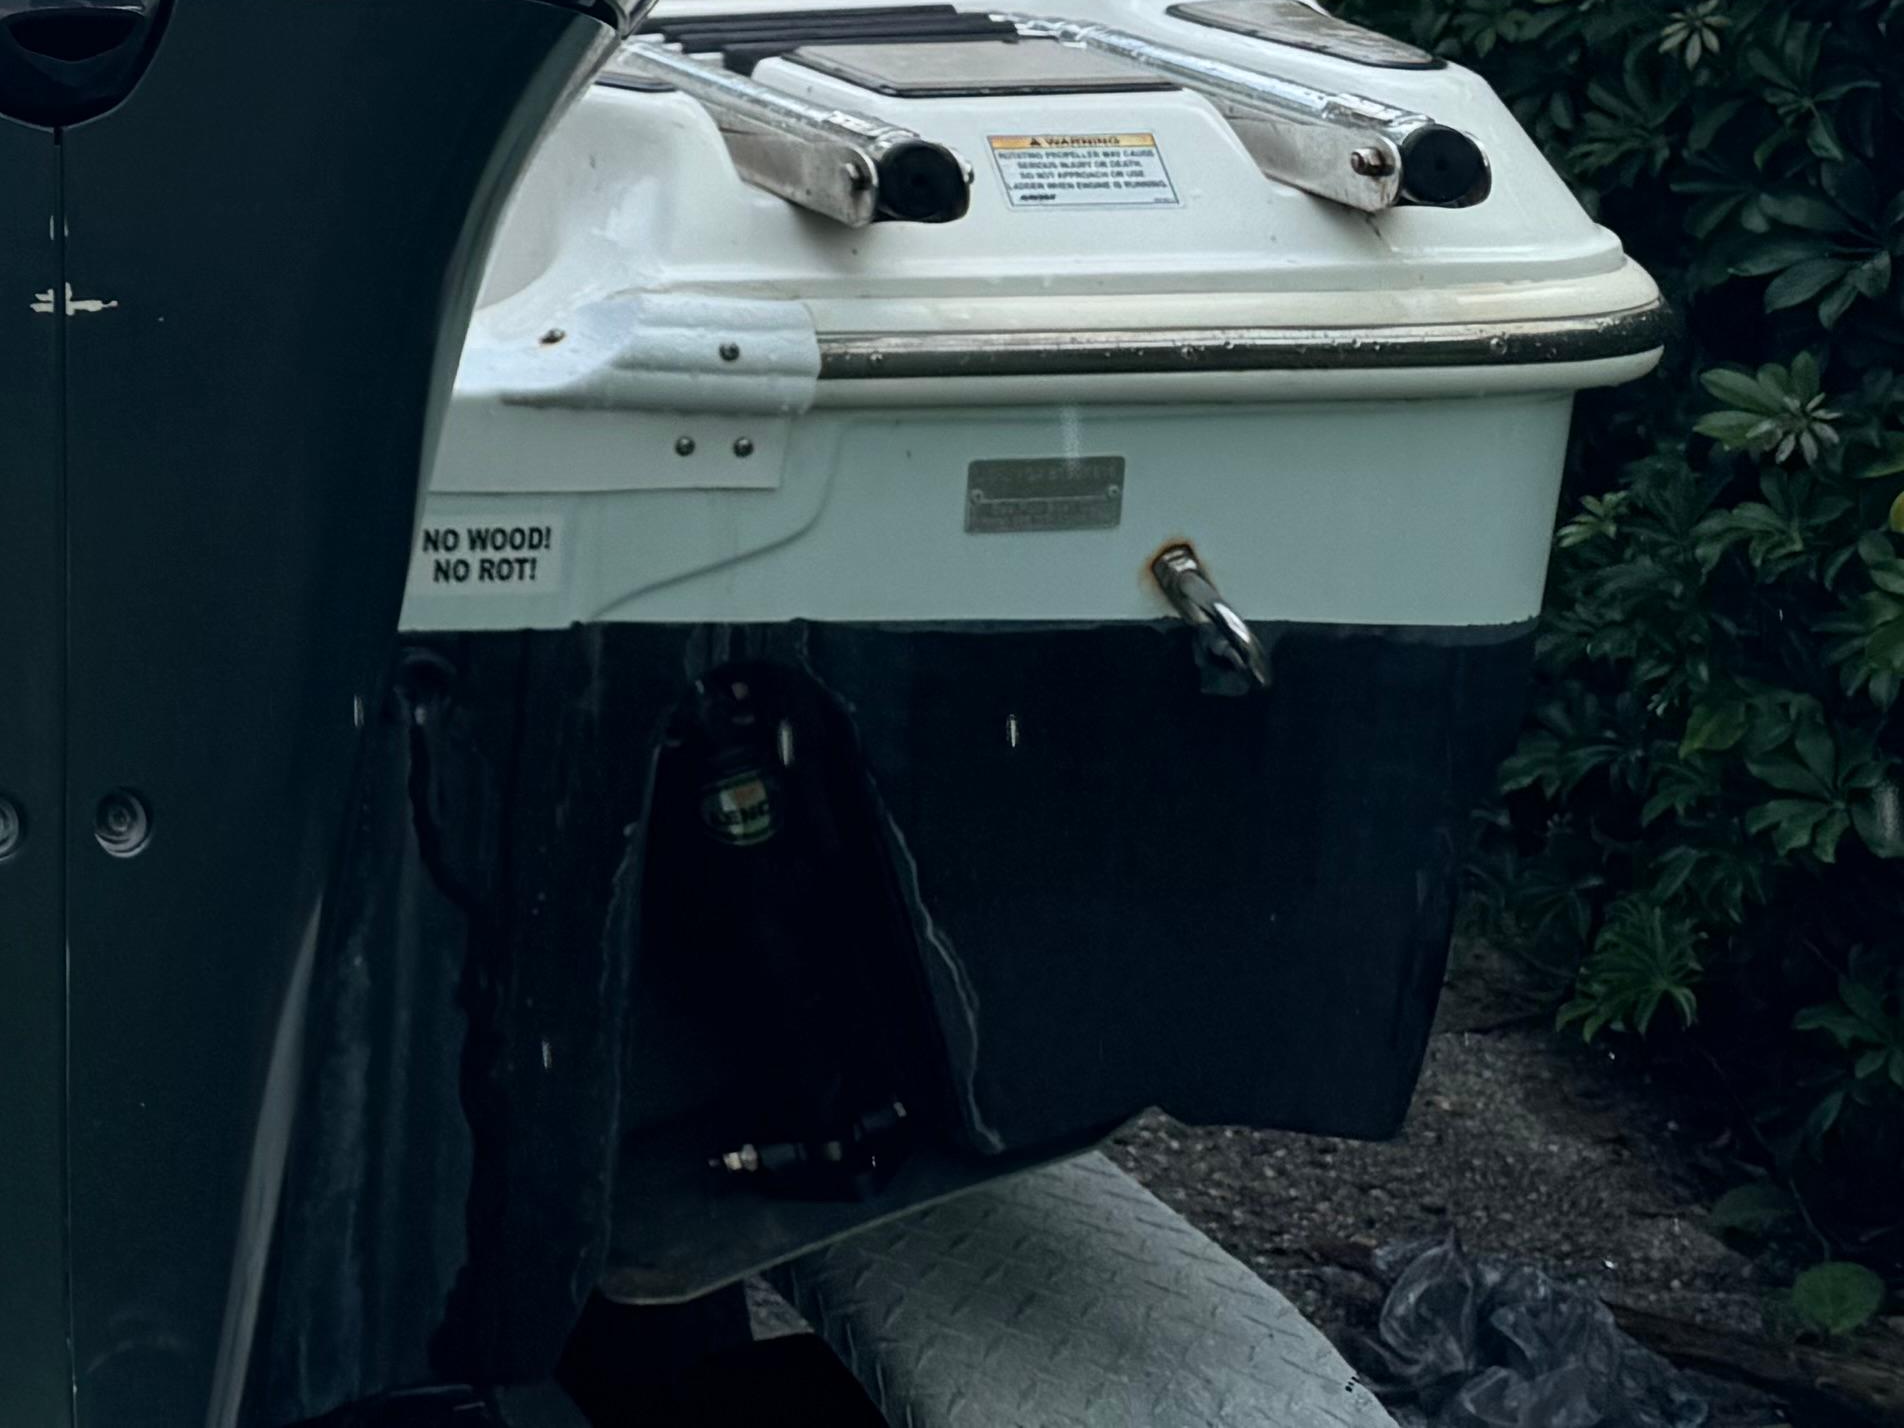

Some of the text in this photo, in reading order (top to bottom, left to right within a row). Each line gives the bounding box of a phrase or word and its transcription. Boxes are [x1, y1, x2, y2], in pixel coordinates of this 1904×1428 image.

[422, 526, 552, 552] NO WOOD!
[432, 556, 538, 583] NO ROT!
